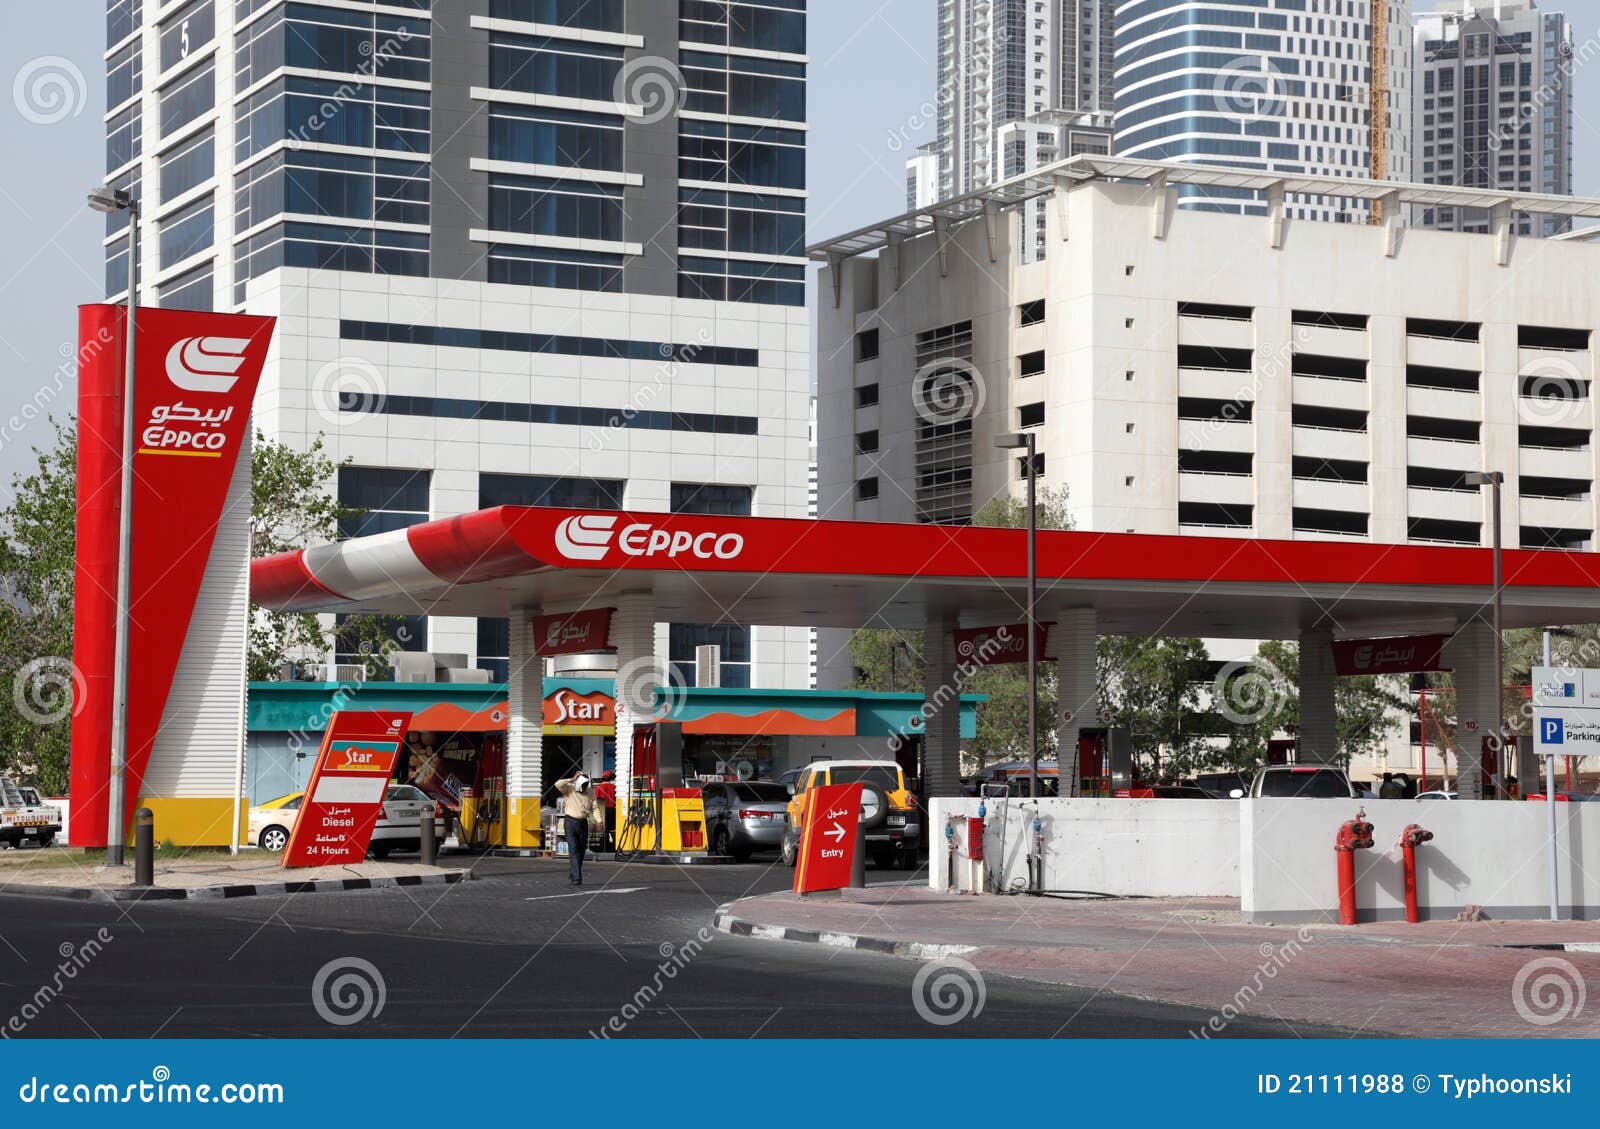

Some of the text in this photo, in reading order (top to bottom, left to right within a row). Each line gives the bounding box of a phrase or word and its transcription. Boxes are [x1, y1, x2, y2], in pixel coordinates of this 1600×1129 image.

[181, 20, 189, 59] 5
[142, 425, 226, 450] EPPCO
[618, 523, 744, 560] EPPCO
[553, 690, 605, 724] Star
[617, 704, 625, 713] 2
[492, 712, 500, 720] 4
[1064, 712, 1071, 721] 6
[1546, 721, 1558, 740] P
[1566, 731, 1600, 743] Parking
[346, 747, 373, 765] Star
[827, 808, 848, 819] دخول
[322, 817, 355, 827] Diesel
[306, 846, 350, 856] 24 Hours
[821, 849, 844, 858] Entry
